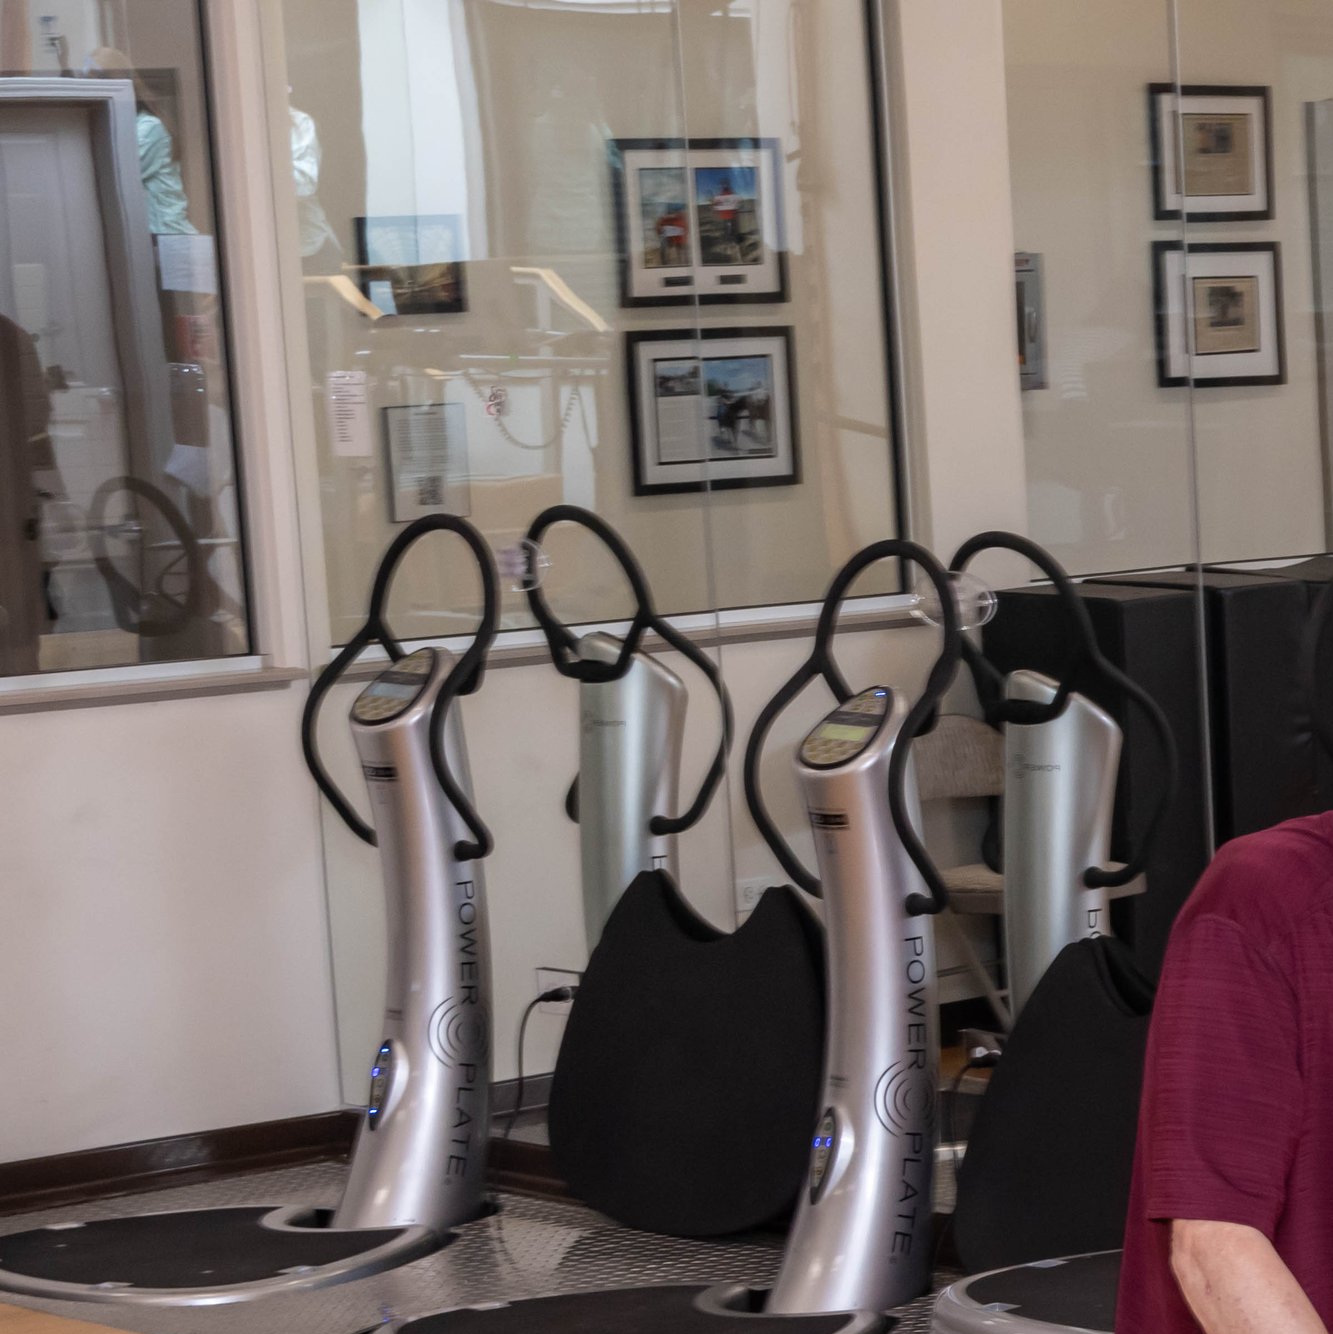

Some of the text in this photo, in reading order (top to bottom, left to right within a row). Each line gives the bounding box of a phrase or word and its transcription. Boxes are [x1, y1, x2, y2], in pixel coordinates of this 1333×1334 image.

[448, 880, 479, 1178] POWER PLATE
[891, 935, 927, 1257] POWER PLATE
